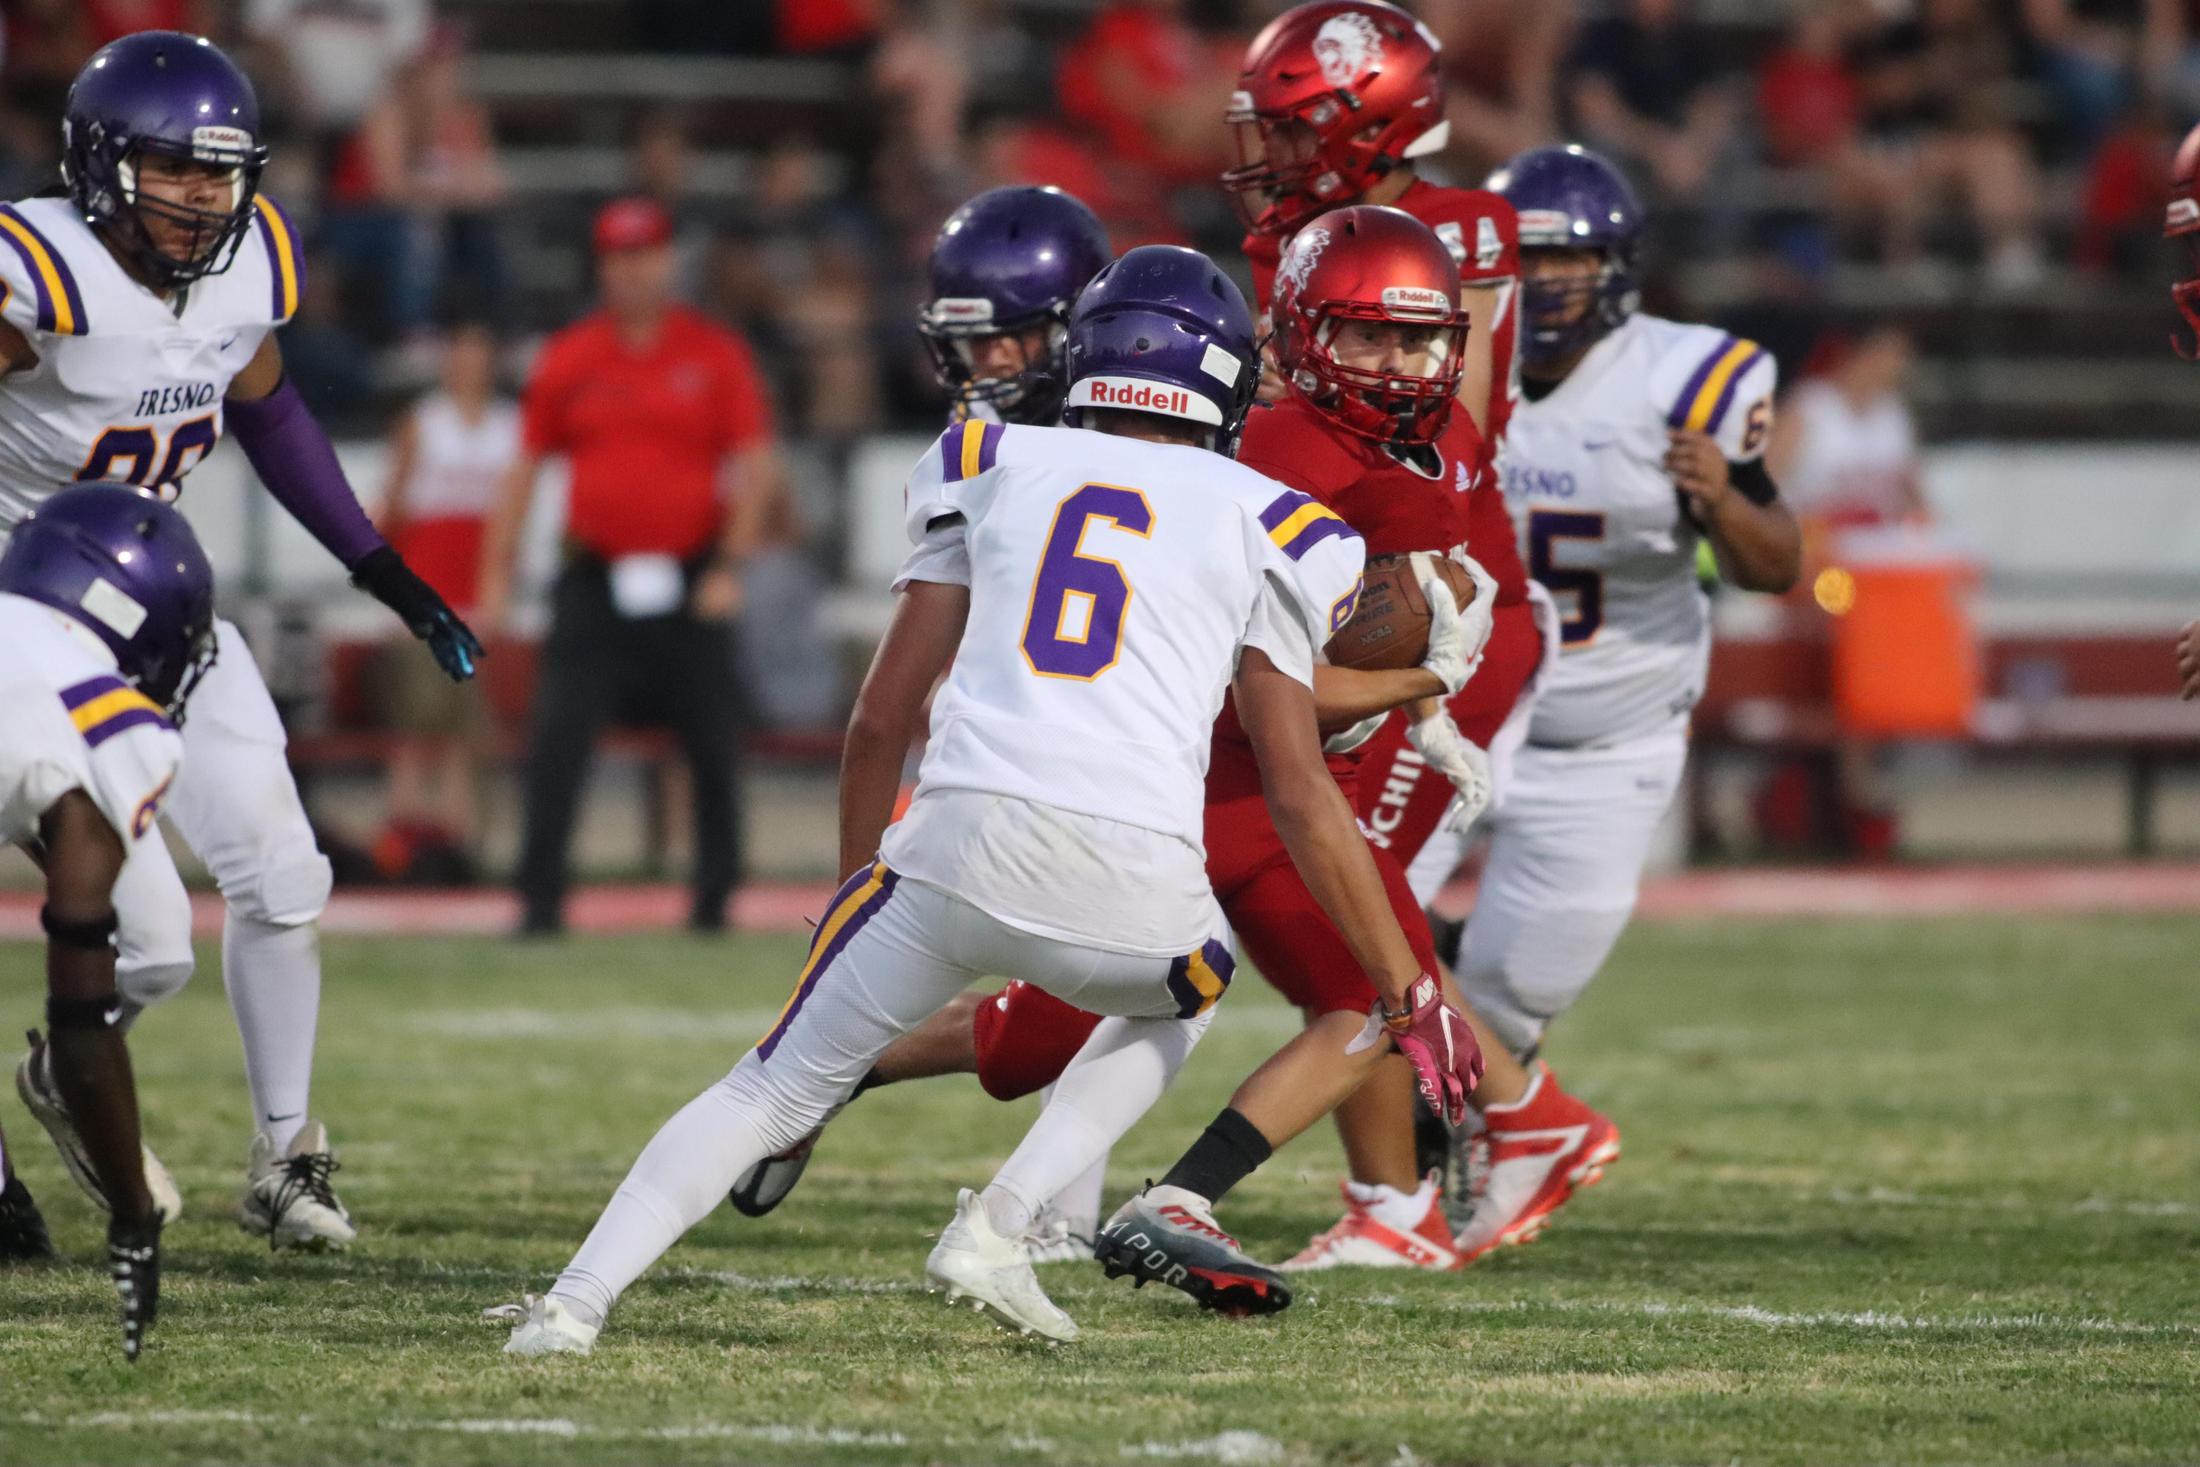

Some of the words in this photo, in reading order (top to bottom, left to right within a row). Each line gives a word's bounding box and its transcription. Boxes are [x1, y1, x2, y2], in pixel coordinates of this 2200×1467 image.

[1397, 289, 1435, 304] Riddell
[135, 382, 215, 417] FRESNO
[1090, 380, 1189, 414] Riddell
[1507, 466, 1577, 497] ESNO
[1018, 482, 1157, 683] 6
